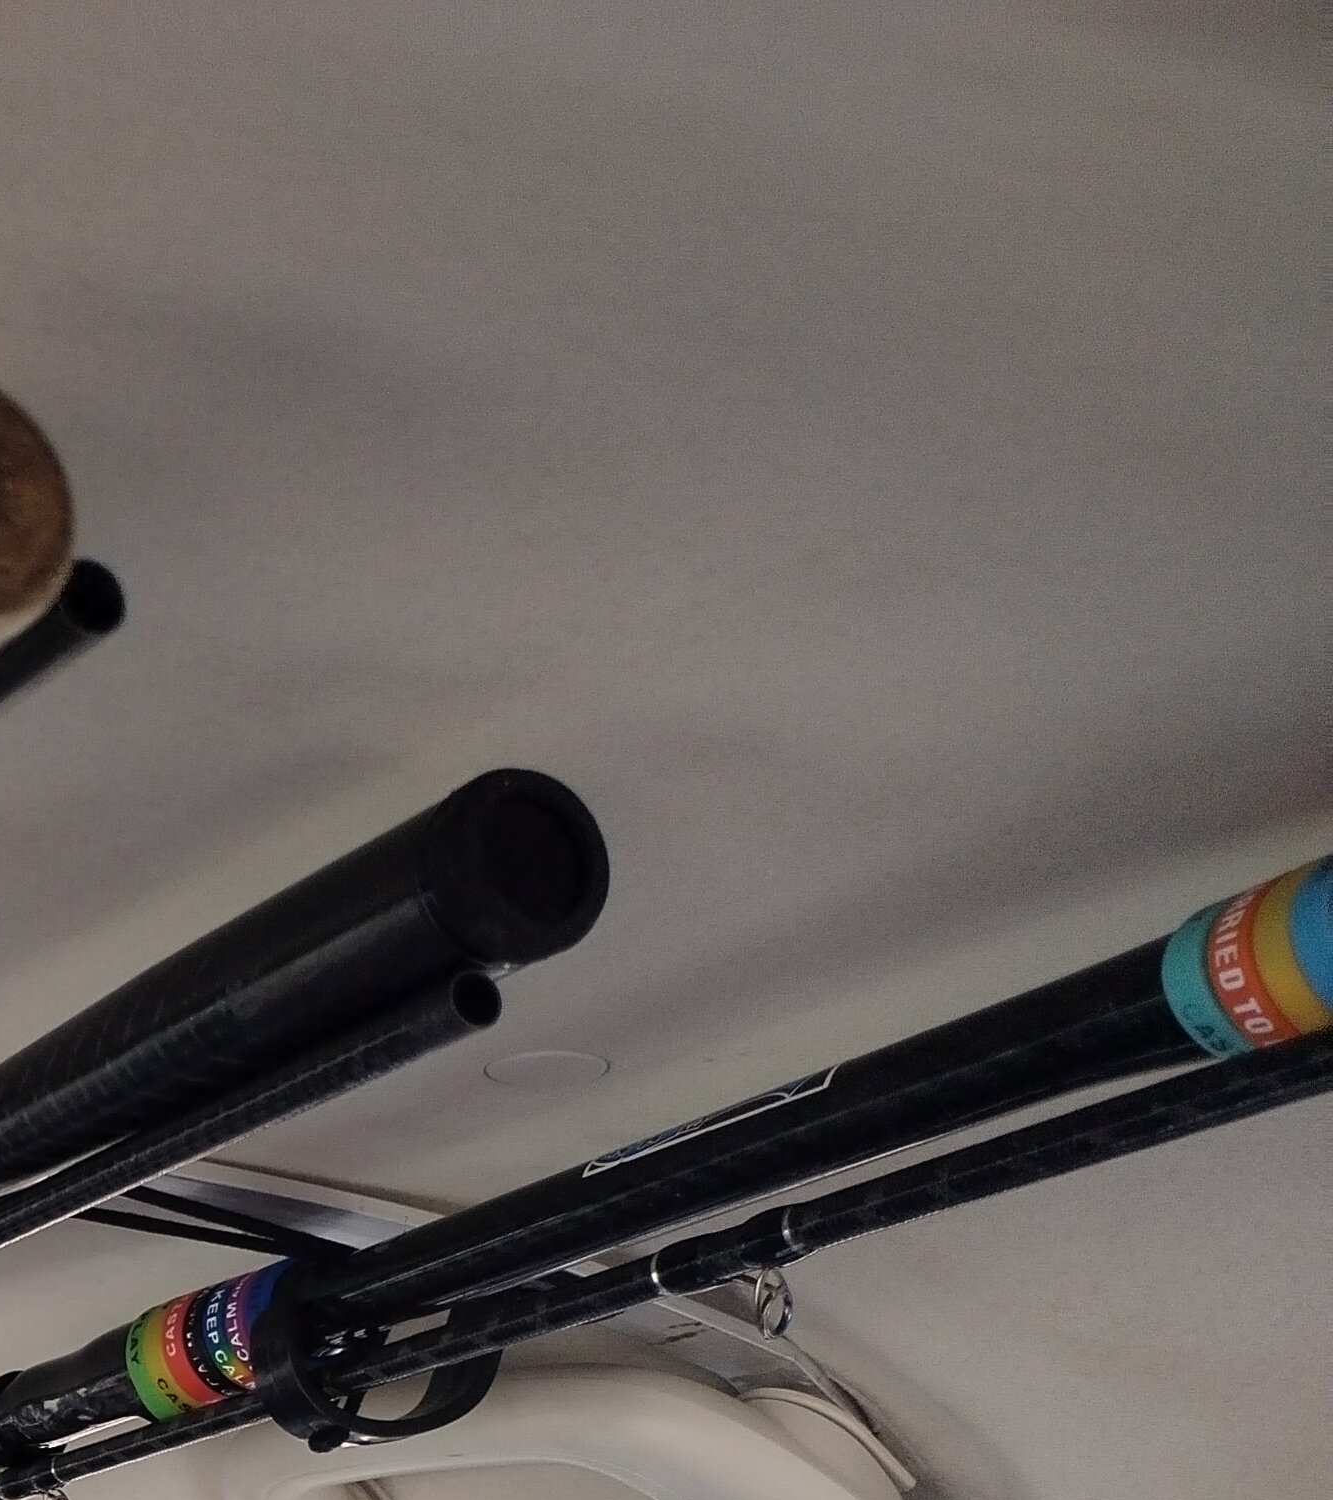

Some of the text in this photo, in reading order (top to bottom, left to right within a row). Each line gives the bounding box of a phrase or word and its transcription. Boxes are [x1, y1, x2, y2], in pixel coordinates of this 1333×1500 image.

[1233, 998, 1274, 1034] TO
[206, 1289, 225, 1344] KEEP
[226, 1301, 250, 1361] CALM
